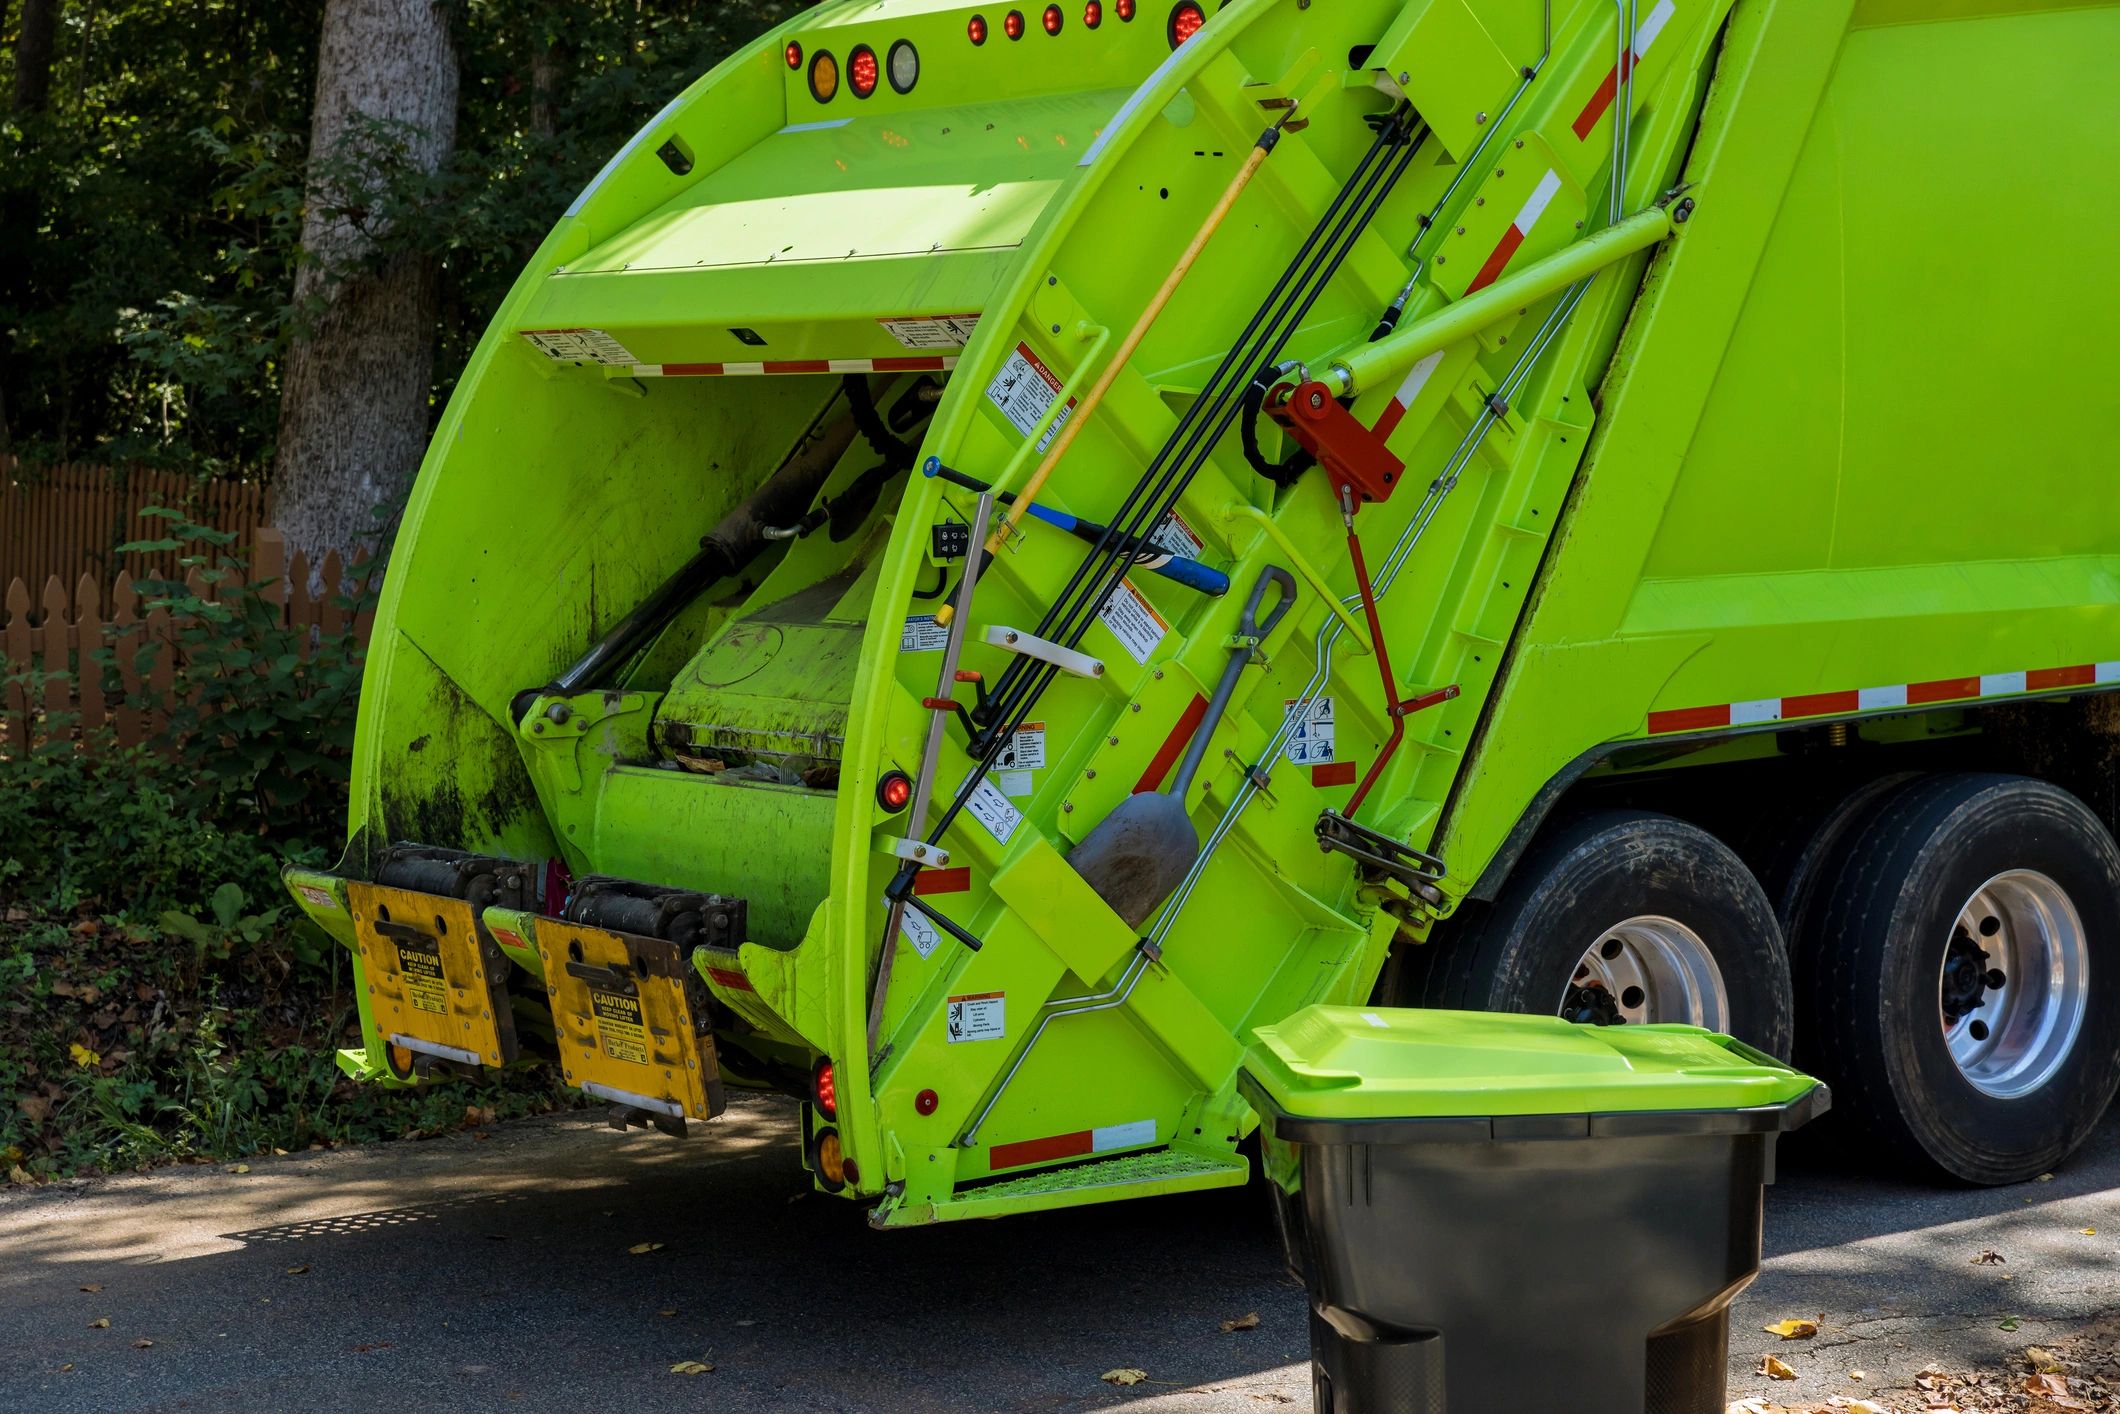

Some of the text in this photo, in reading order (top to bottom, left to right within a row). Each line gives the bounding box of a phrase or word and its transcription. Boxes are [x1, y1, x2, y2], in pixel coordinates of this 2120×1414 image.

[1039, 365, 1062, 393] DANGER
[400, 949, 439, 966] CAUTION
[593, 992, 638, 1012] CAUTION
